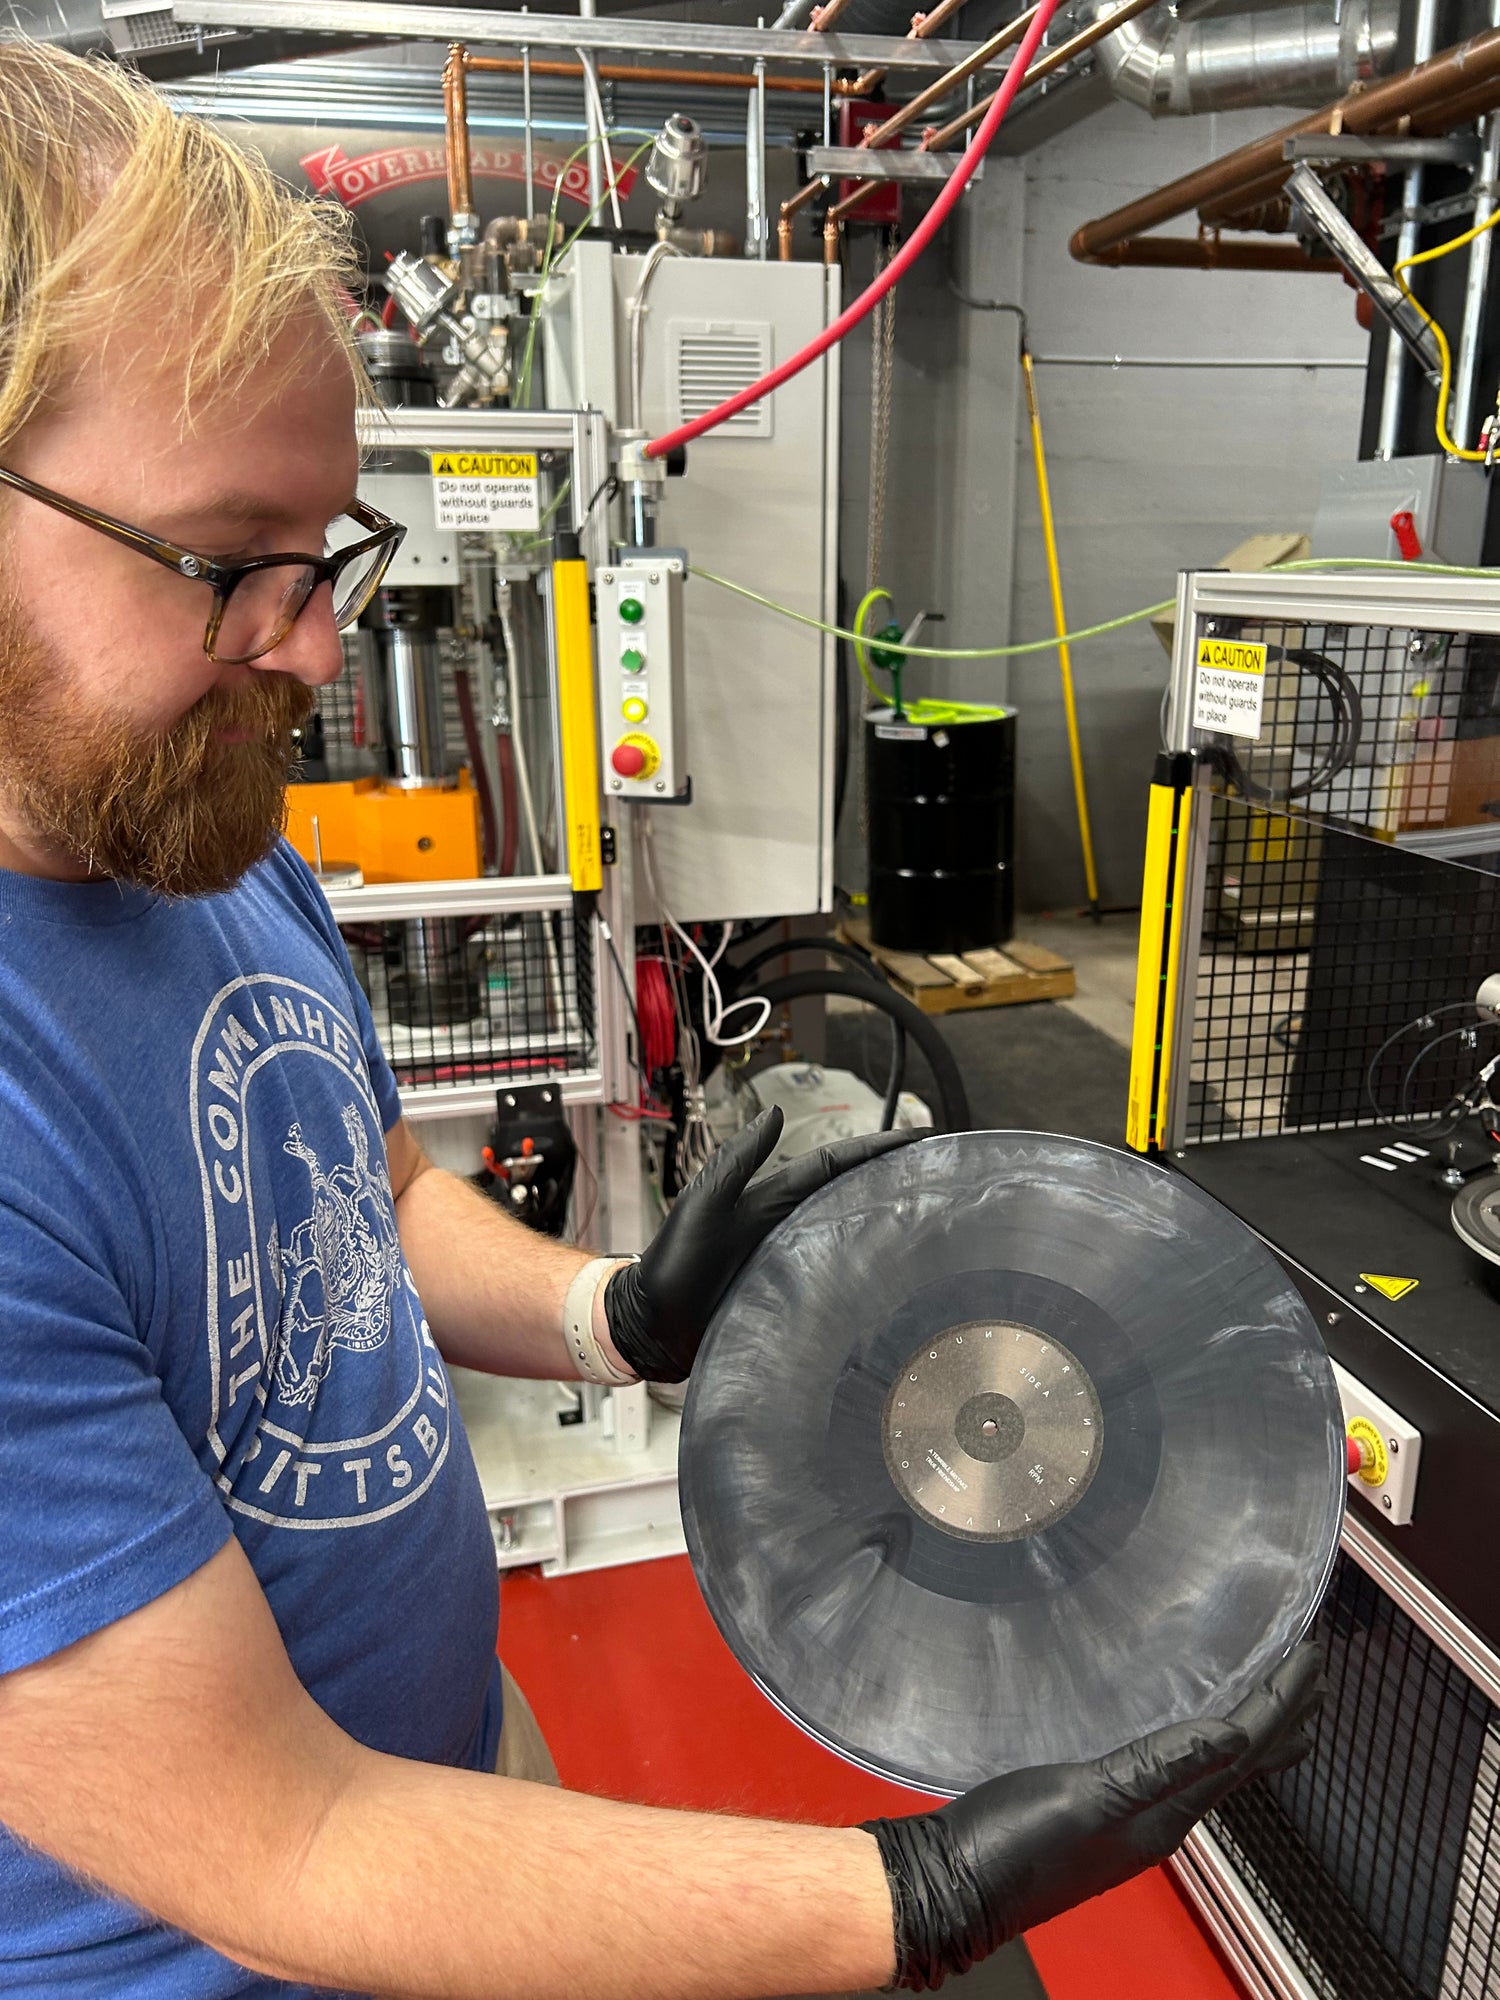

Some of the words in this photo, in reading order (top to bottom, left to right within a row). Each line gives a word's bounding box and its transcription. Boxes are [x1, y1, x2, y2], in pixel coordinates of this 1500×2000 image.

[341, 150, 512, 194] OVERHAD
[521, 156, 593, 196] DOO
[457, 457, 532, 475] CAUTION
[440, 481, 457, 492] Do
[460, 482, 481, 492] not
[484, 482, 532, 495] operate
[440, 497, 487, 509] without
[490, 498, 533, 511] guards
[441, 512, 454, 523] in
[456, 512, 490, 524] place
[1213, 646, 1261, 670] CAUTION
[1200, 672, 1210, 684] Do
[1213, 675, 1225, 688] not
[1227, 677, 1258, 692] operate
[1199, 691, 1227, 706] without
[1229, 696, 1257, 711] guards
[1198, 706, 1204, 718] in
[1206, 708, 1227, 723] place
[227, 1251, 261, 1408] THE
[347, 1334, 383, 1349] LIBERTY
[1020, 1367, 1041, 1389] SIDE
[1042, 1390, 1050, 1398] A
[932, 1451, 951, 1472] TERRIBLE
[1034, 1464, 1044, 1474] 45
[926, 1456, 938, 1469] TRUE
[936, 1467, 960, 1492] FRIENDSHIP
[1028, 1468, 1044, 1485] RPM
